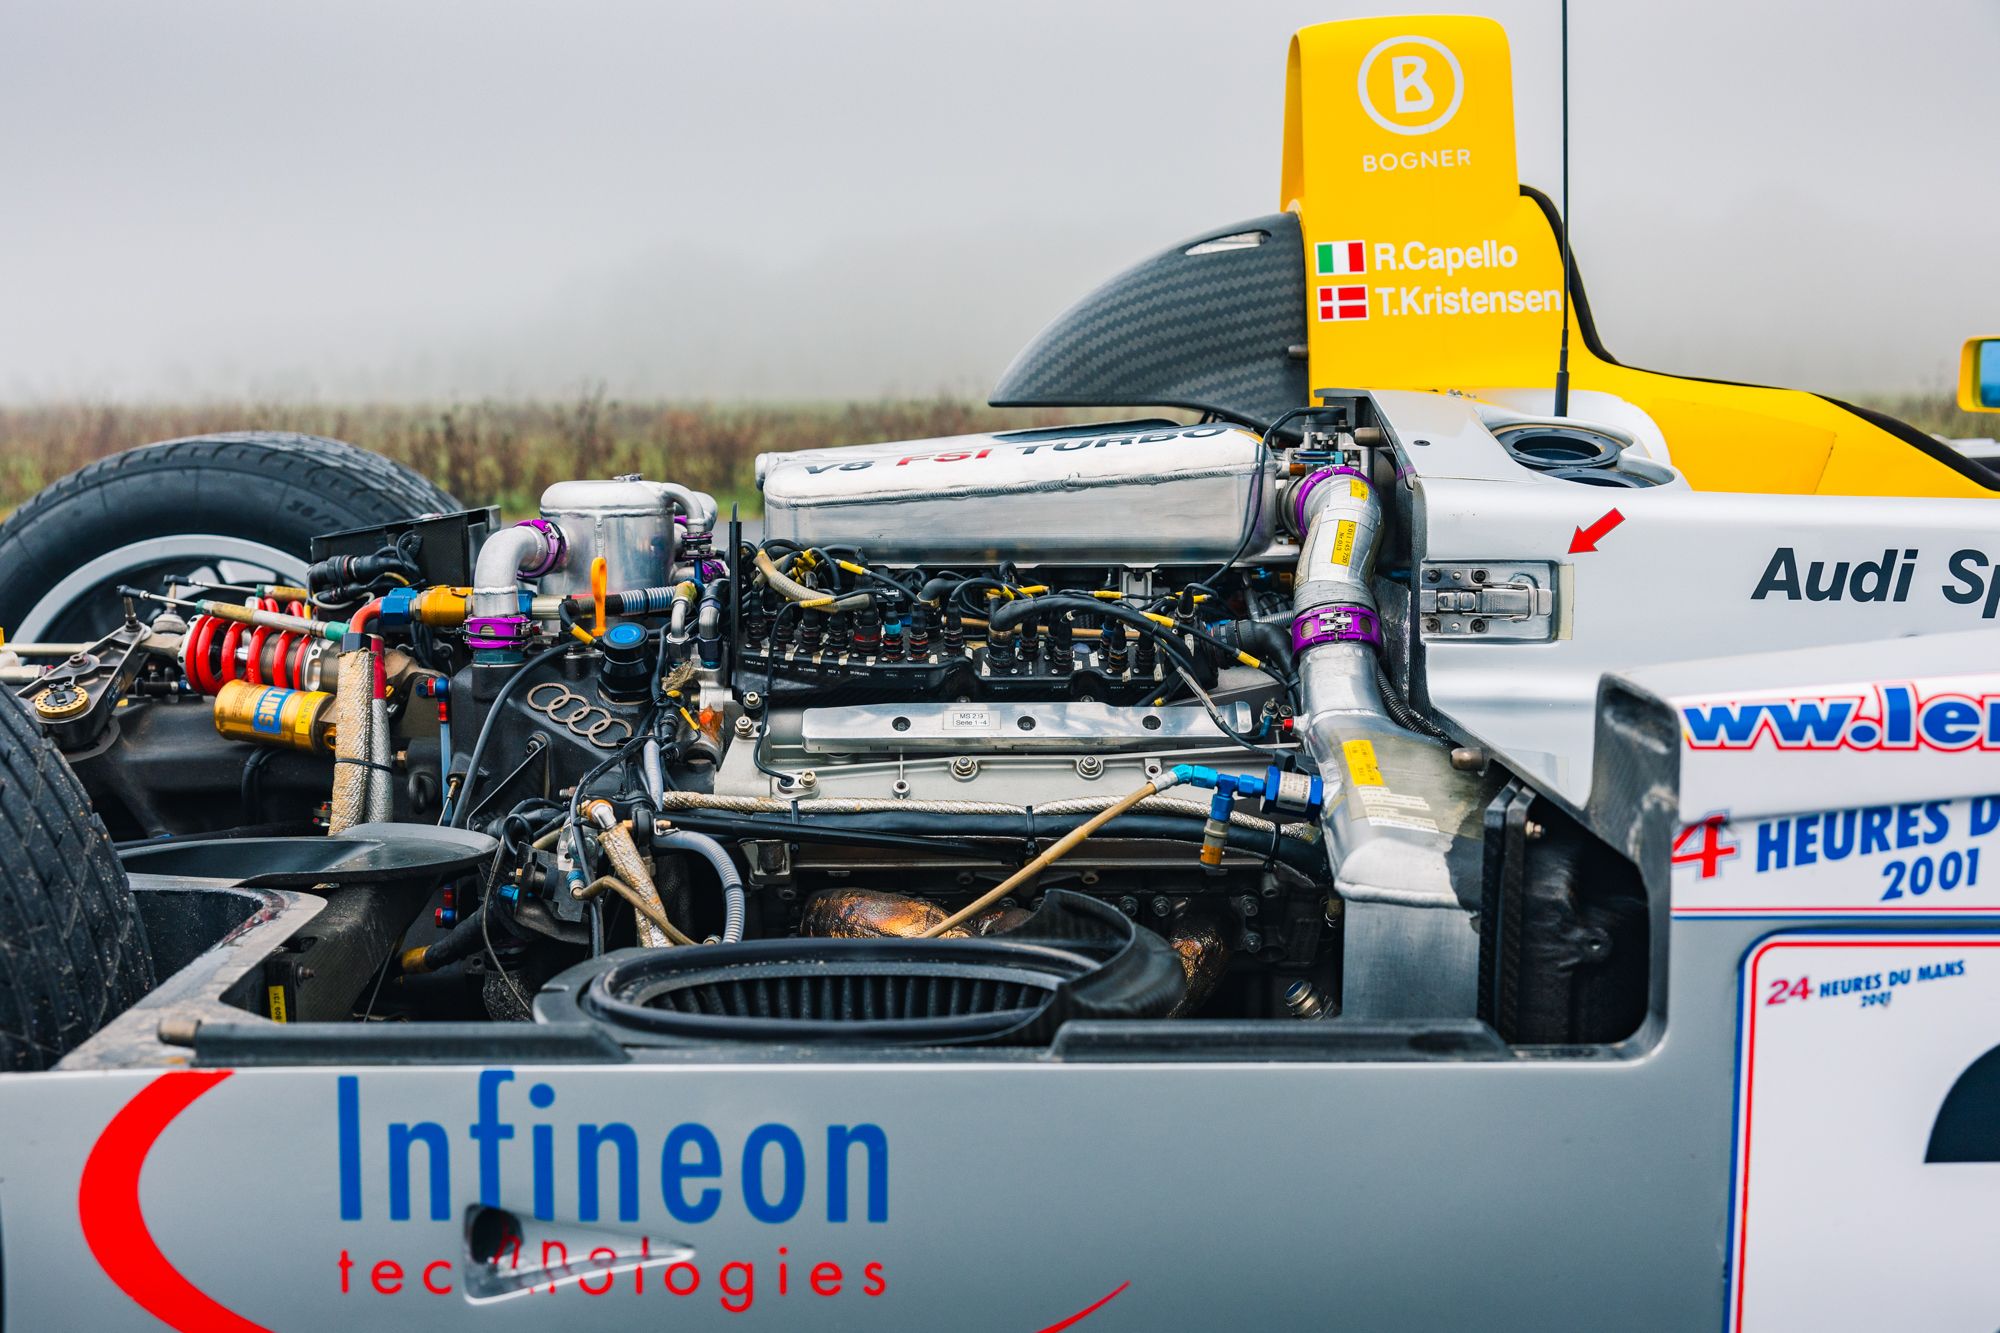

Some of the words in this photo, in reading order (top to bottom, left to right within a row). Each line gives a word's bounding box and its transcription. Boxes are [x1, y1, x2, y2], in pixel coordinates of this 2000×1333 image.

[1392, 55, 1434, 114] B
[1363, 149, 1472, 172] BOGNER
[1374, 239, 1518, 277] R.Capello
[1374, 285, 1562, 316] T.Kristensen
[805, 460, 874, 475] V8
[896, 449, 993, 466] FSI
[1022, 427, 1227, 455] TURBO
[1751, 547, 1919, 602] Audi
[1756, 802, 1950, 874] HEURES
[1879, 847, 1980, 902] 2001
[1766, 977, 1813, 1006] 24
[1818, 973, 1882, 999] HEURES
[1888, 968, 1911, 988] DU
[1917, 959, 1966, 982] MANS
[338, 1069, 889, 1222] Infineon
